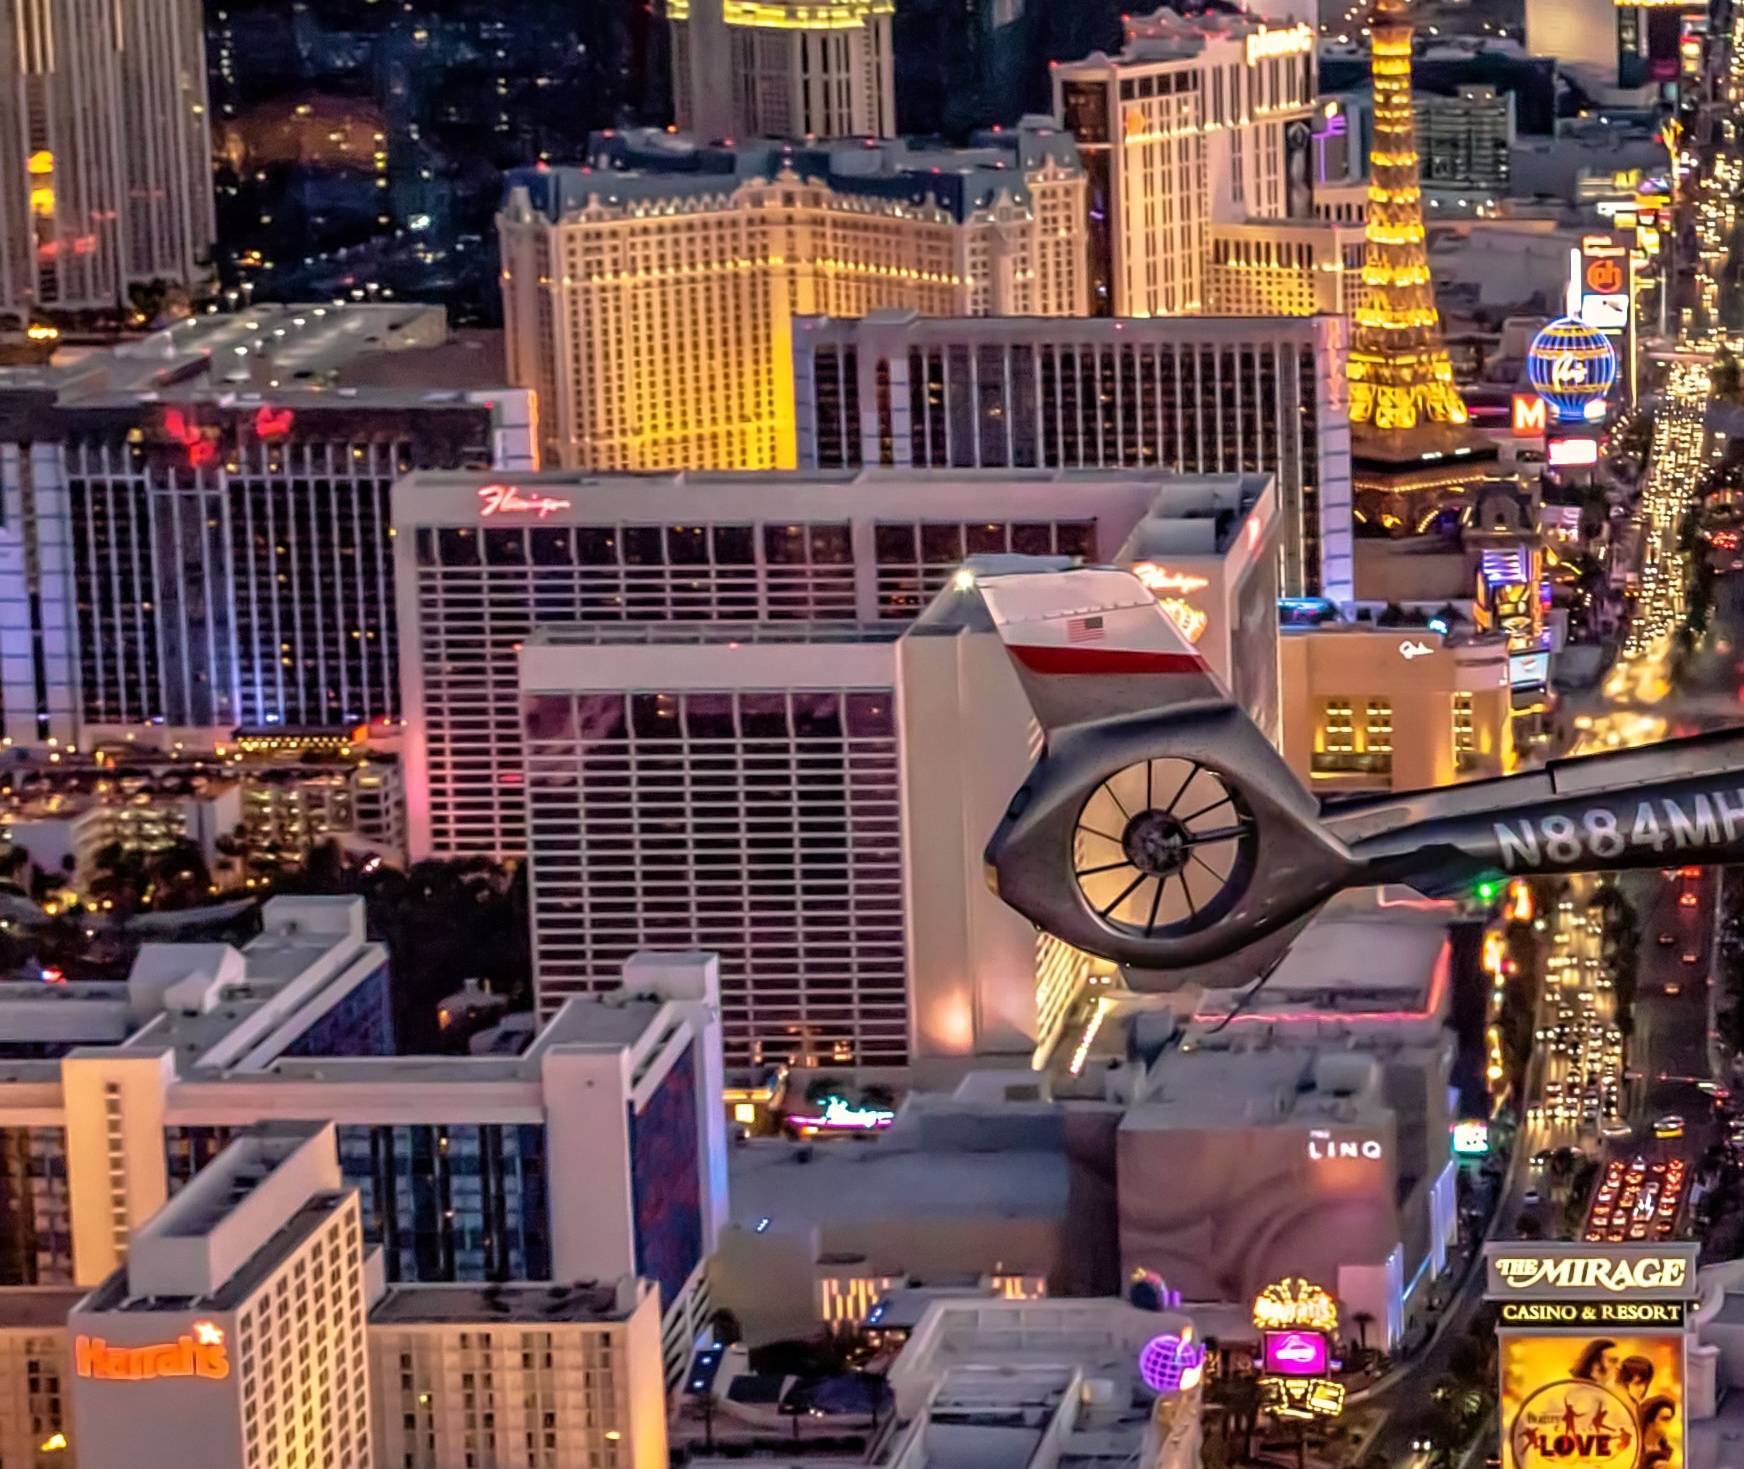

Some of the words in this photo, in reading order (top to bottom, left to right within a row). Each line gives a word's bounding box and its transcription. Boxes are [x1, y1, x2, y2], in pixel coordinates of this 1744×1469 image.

[478, 485, 570, 518] Flig
[1309, 1140, 1382, 1159] LINQ
[1495, 1258, 1538, 1275] THE
[1507, 1258, 1686, 1292] MIRAGE
[1503, 1305, 1577, 1320] CASINO
[1582, 1305, 1597, 1320] &
[1602, 1305, 1681, 1320] RESORT
[1539, 1435, 1612, 1457] LOVE
